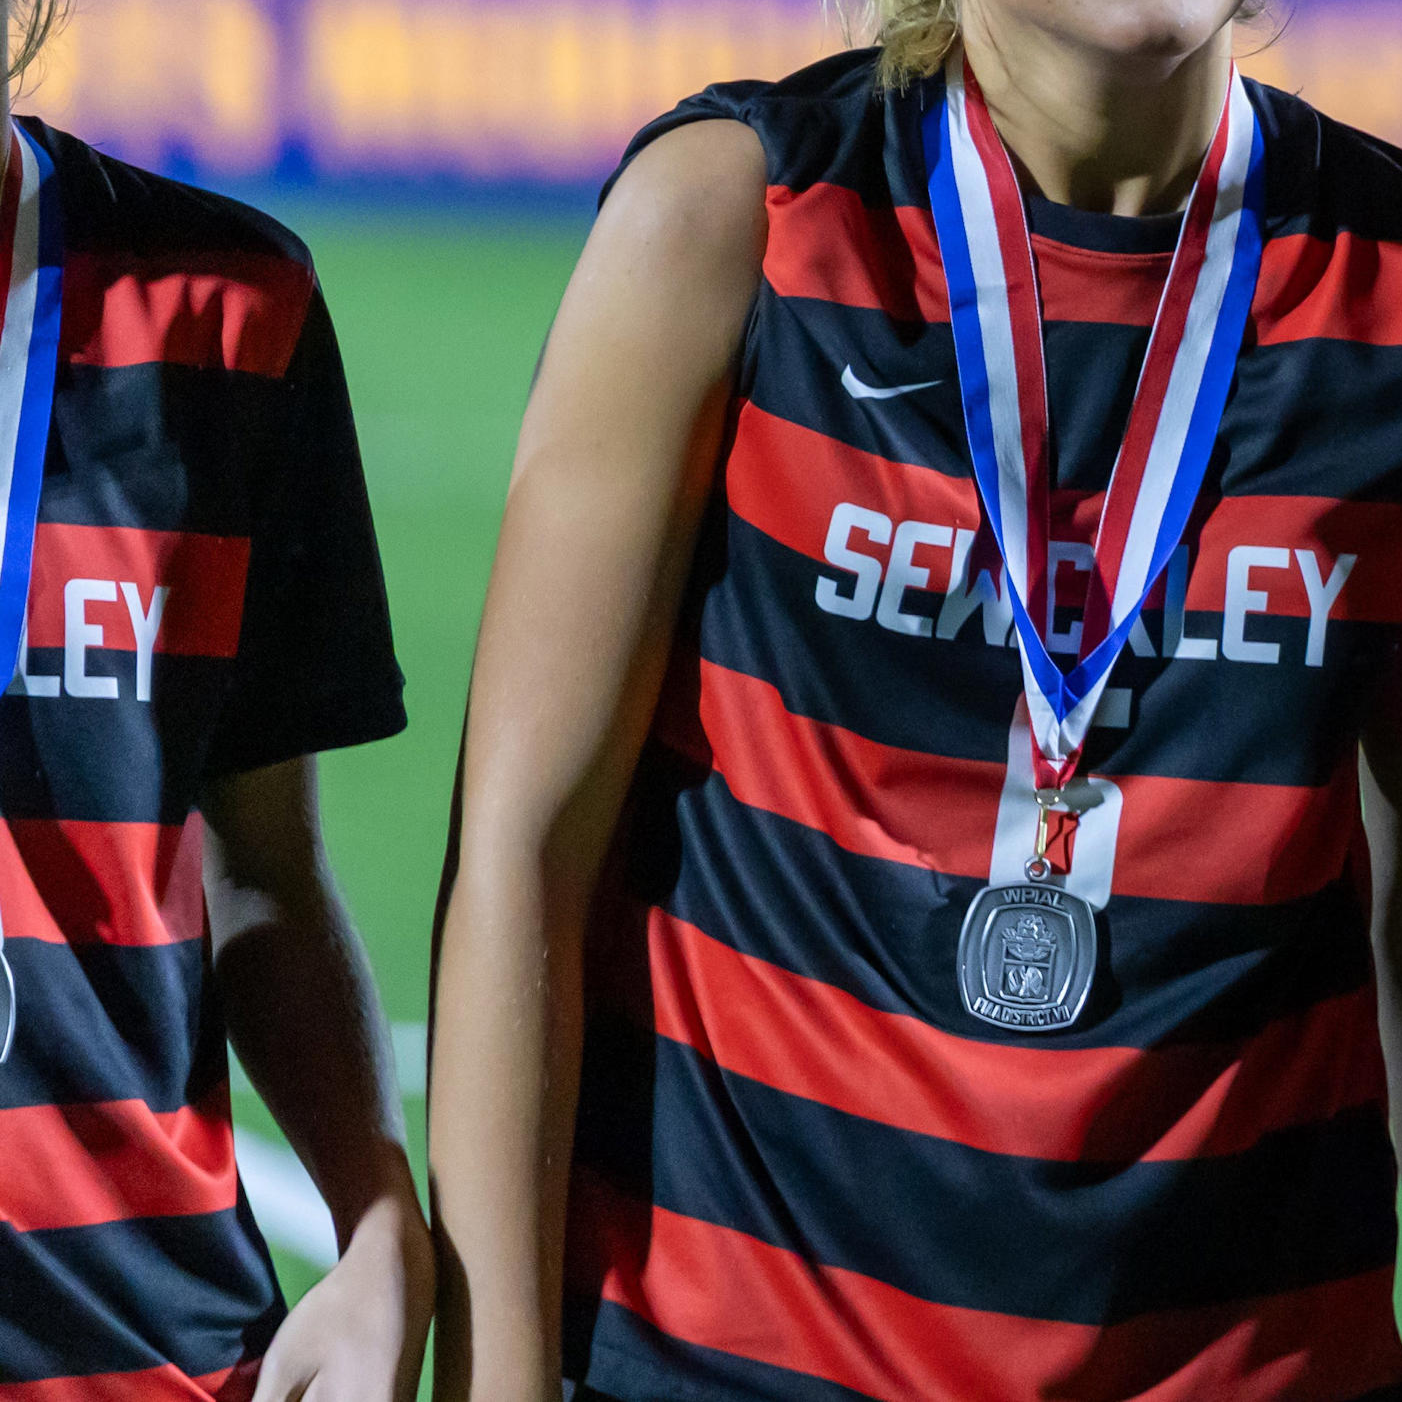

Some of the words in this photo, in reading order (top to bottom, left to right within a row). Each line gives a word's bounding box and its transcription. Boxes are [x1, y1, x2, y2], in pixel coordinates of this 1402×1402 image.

[814, 501, 1358, 668] SEWCLEY
[1001, 887, 1067, 909] WPIAL
[1001, 1006, 1052, 1026] DISTRICT
